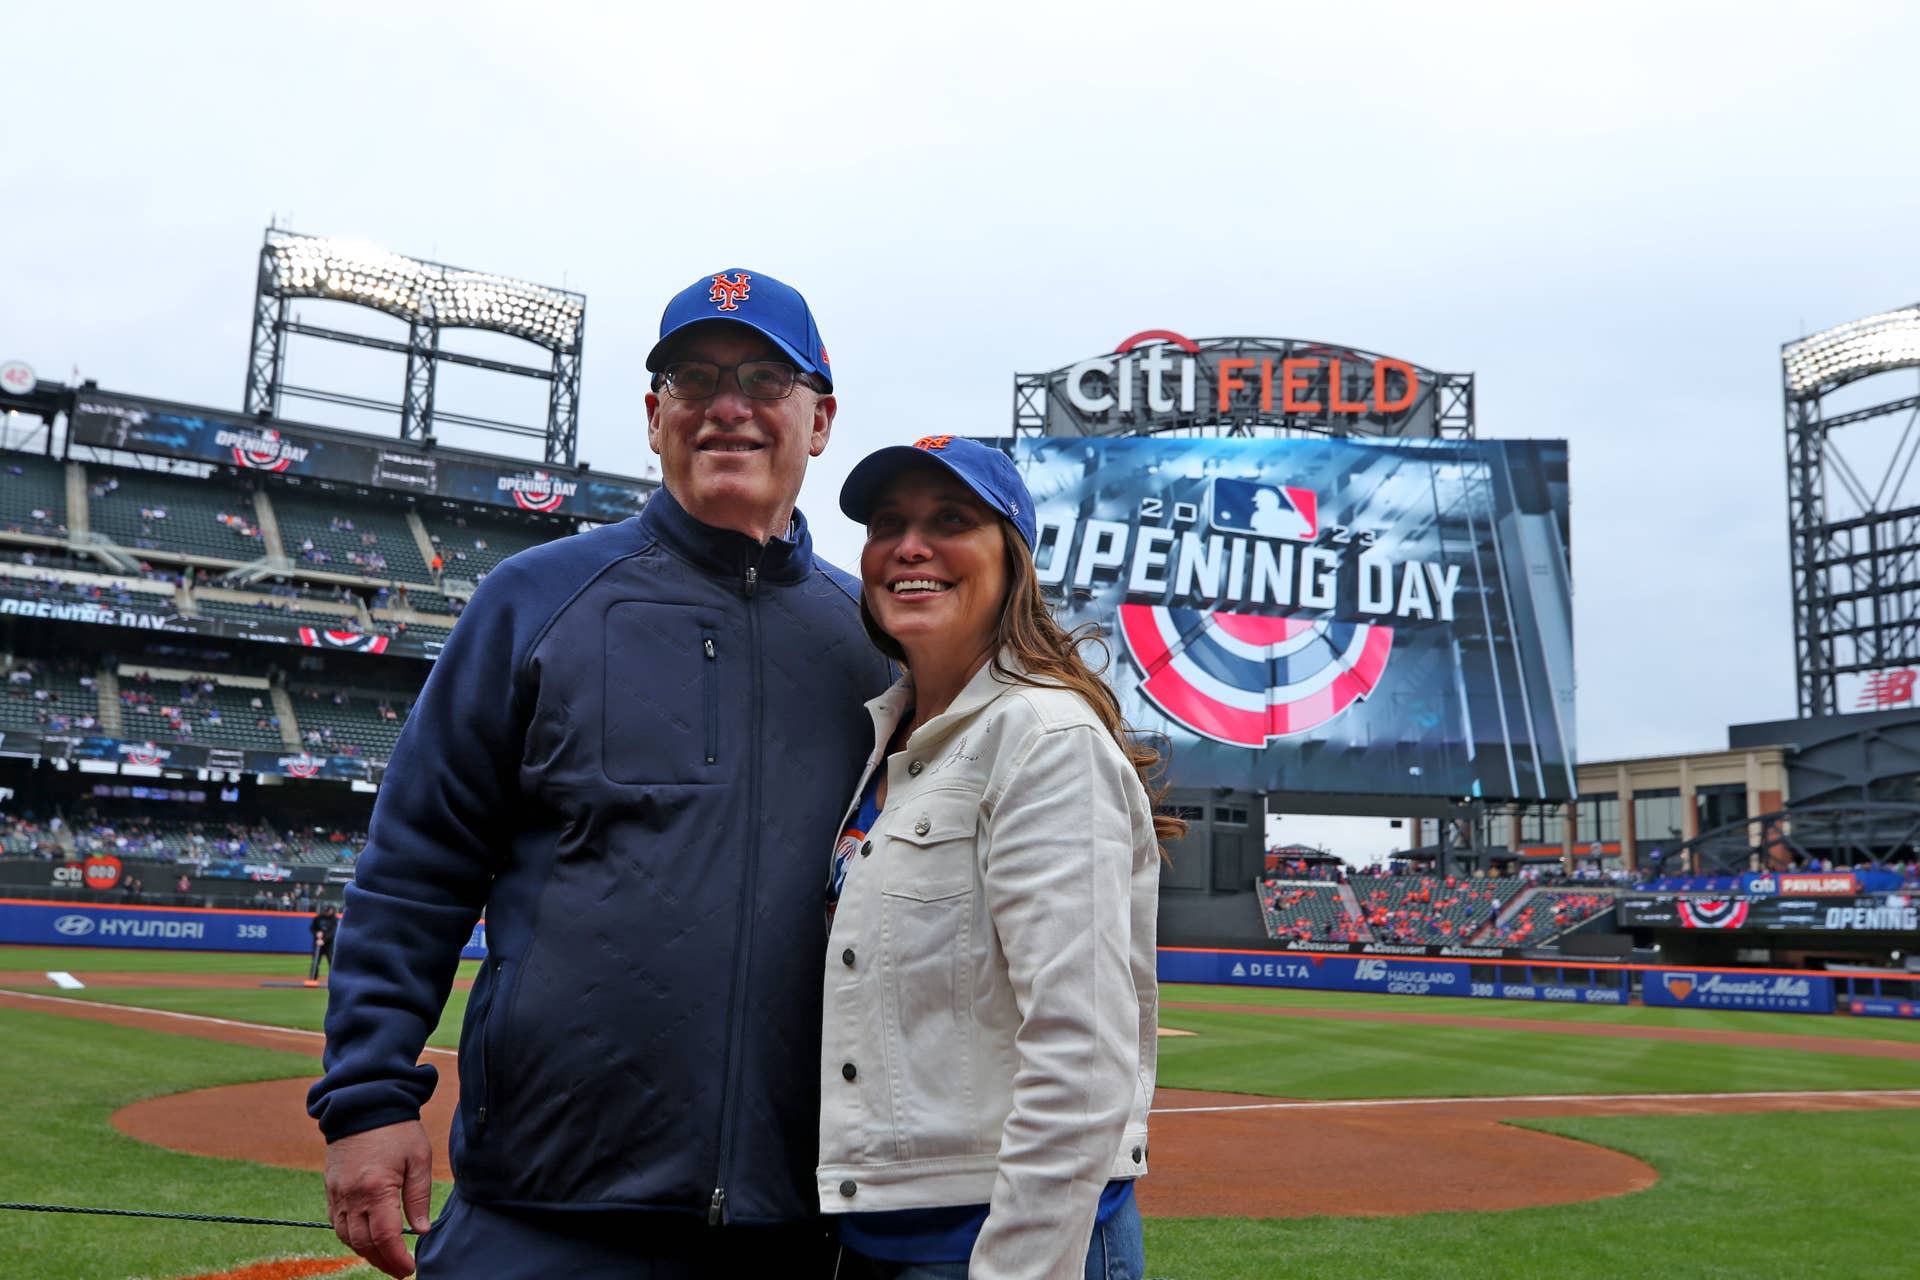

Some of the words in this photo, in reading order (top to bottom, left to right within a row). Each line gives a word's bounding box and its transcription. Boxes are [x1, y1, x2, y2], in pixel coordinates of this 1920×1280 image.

[709, 273, 751, 311] NY
[4, 368, 29, 387] 42
[1218, 357, 1418, 413] FIELD
[215, 430, 280, 457] OPENING
[281, 444, 309, 462] DAY
[498, 477, 551, 494] OPENING
[553, 482, 577, 496] DAY
[1035, 512, 1338, 609] OPENING
[1358, 552, 1460, 621] DAY
[1782, 879, 1851, 893] PAVILION
[100, 918, 204, 939] HYUNDAI
[237, 924, 267, 938] 358
[1825, 907, 1918, 931] OPENING
[1250, 963, 1310, 979] DELTA
[1387, 970, 1455, 984] HAUGLAND
[1388, 982, 1430, 994] GROUP
[1470, 983, 1494, 997] 380
